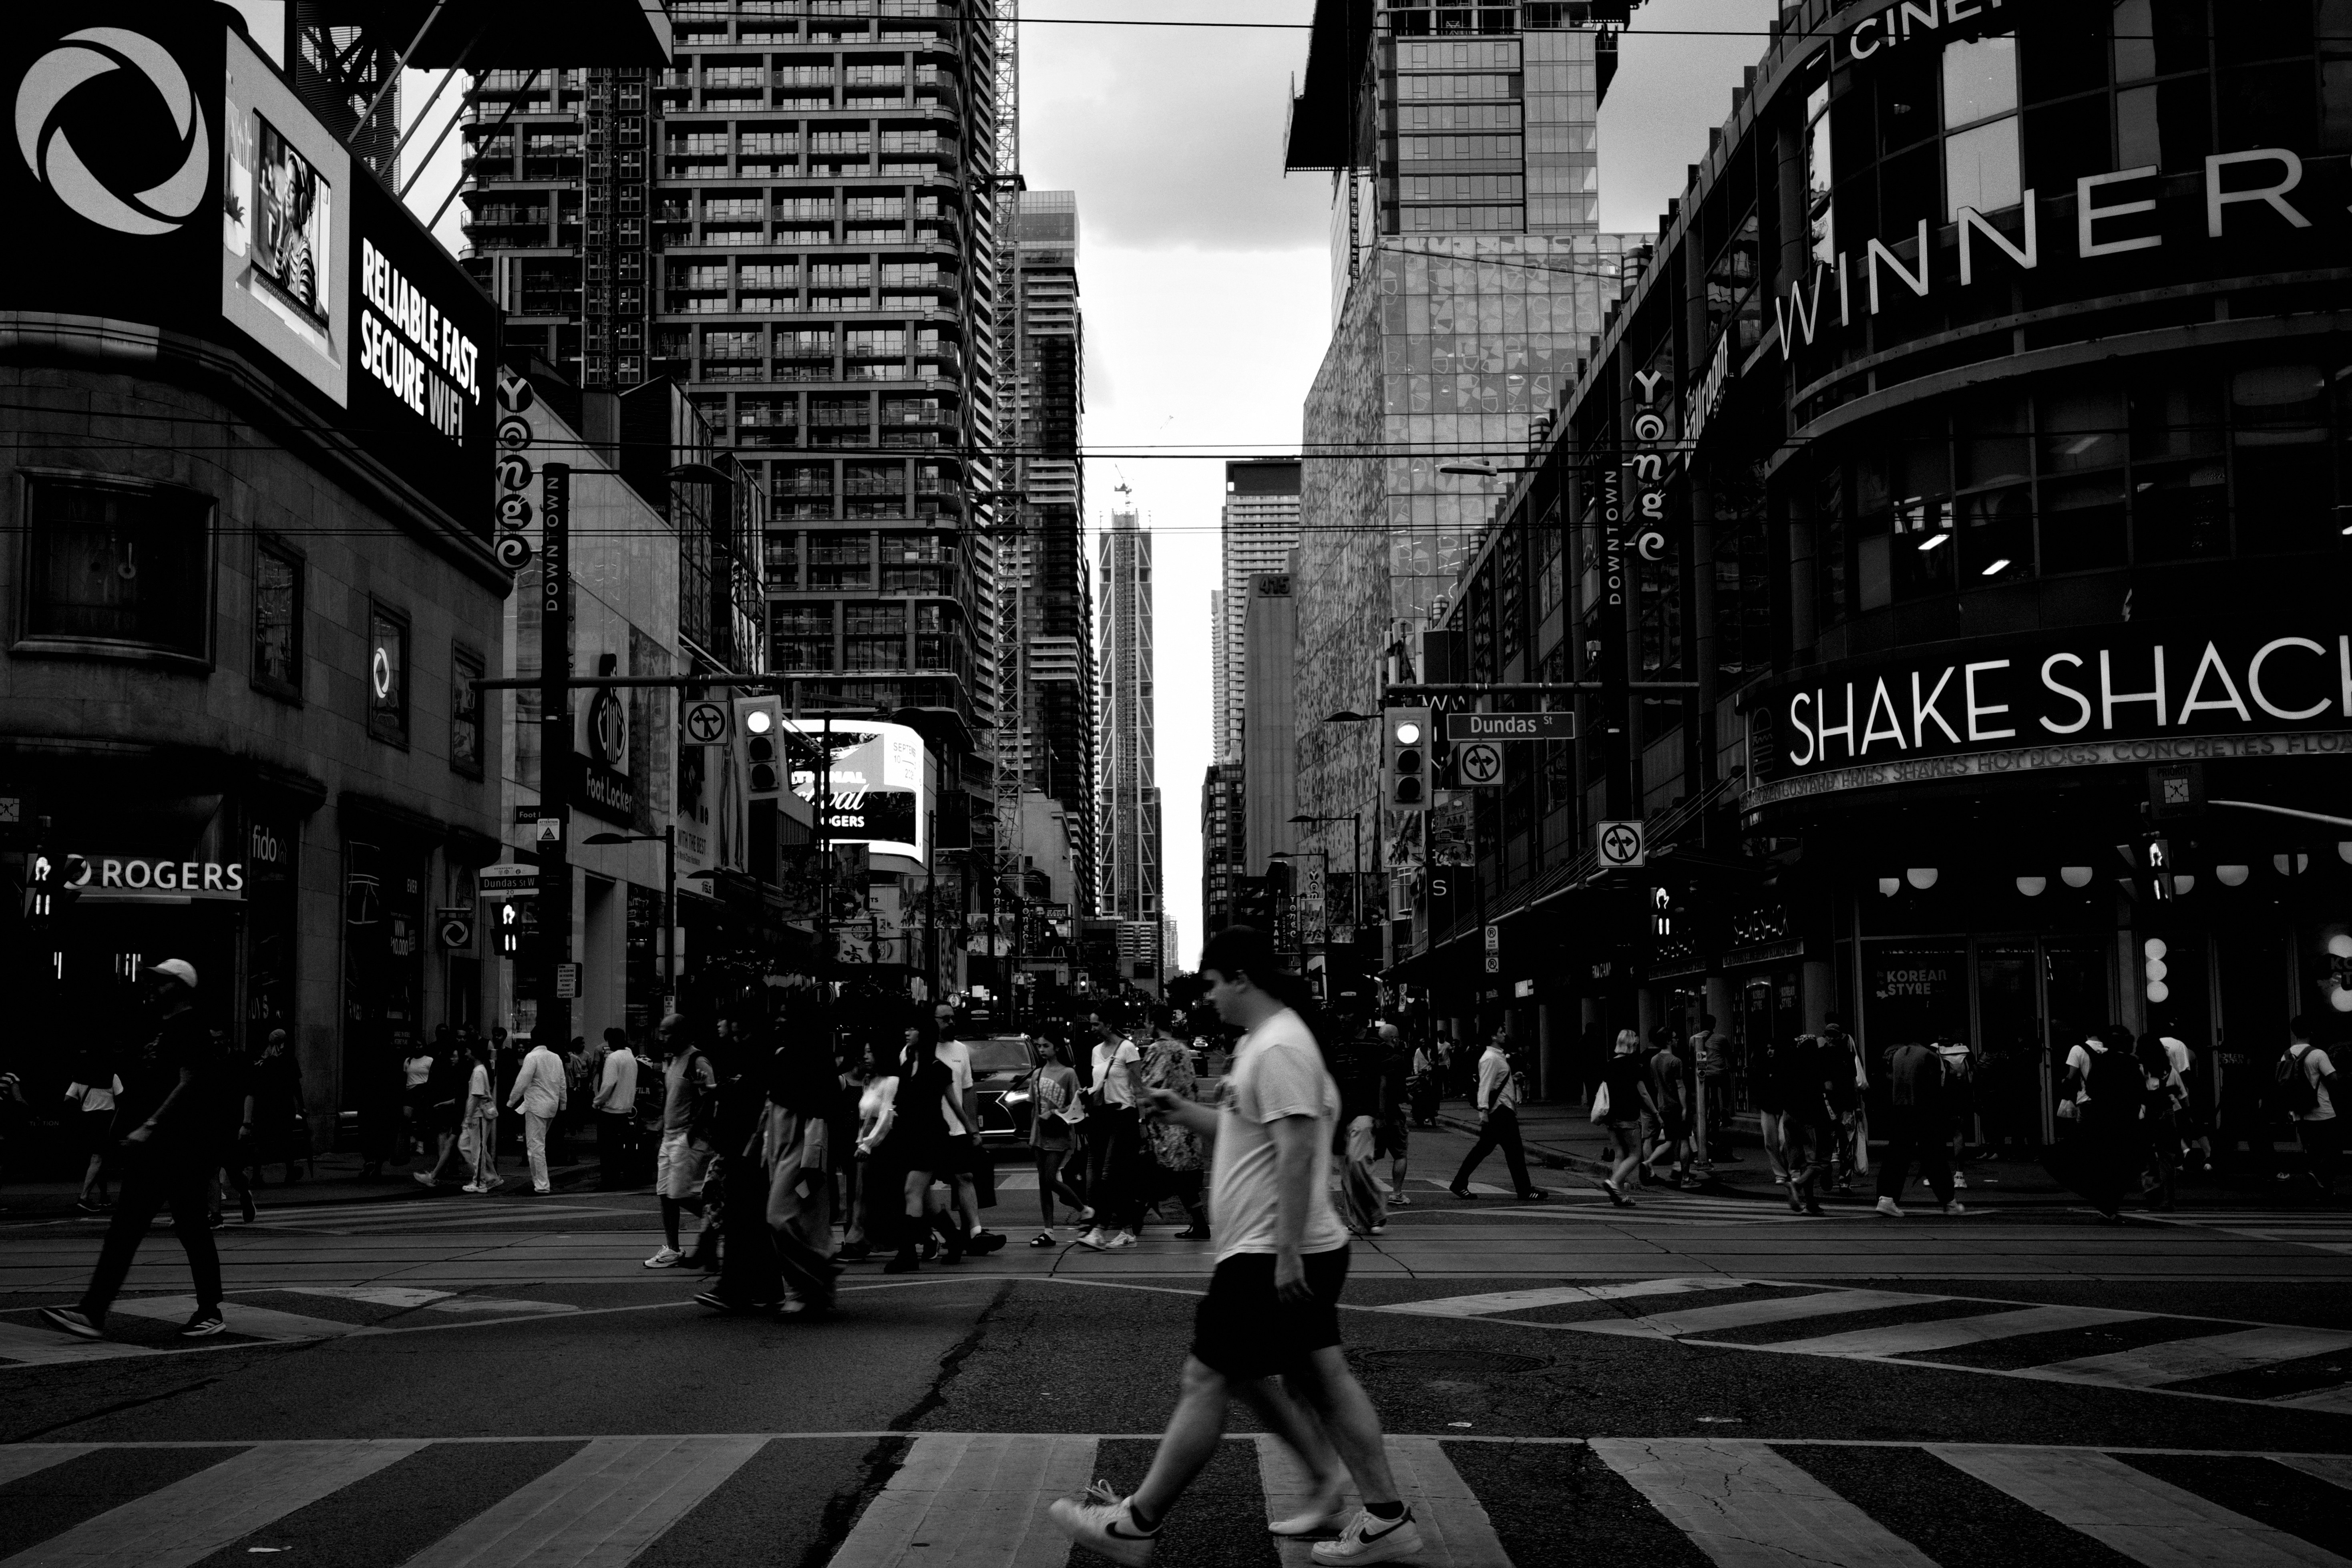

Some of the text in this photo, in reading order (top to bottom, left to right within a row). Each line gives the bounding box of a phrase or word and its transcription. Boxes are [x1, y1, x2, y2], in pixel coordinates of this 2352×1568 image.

[1850, 0, 2002, 60] CINE
[1775, 147, 2352, 361] WINNER
[362, 237, 480, 406] RELIABLE FAST,
[360, 309, 463, 448] SECURE WIFI
[497, 377, 530, 569] Yonge
[1631, 370, 1666, 561] Yonge
[546, 477, 559, 611] DOWNTOWN
[1604, 470, 1621, 605] DOWNTOWN
[1470, 716, 1553, 733] Dundas St
[1789, 659, 2016, 767] SHAKE
[587, 767, 632, 814] Foot Locker
[2157, 765, 2192, 777] PRIORITY
[102, 859, 243, 891] ROGERS
[252, 824, 277, 862] fido
[484, 877, 535, 888] Dundas St W
[394, 919, 405, 937] WIN
